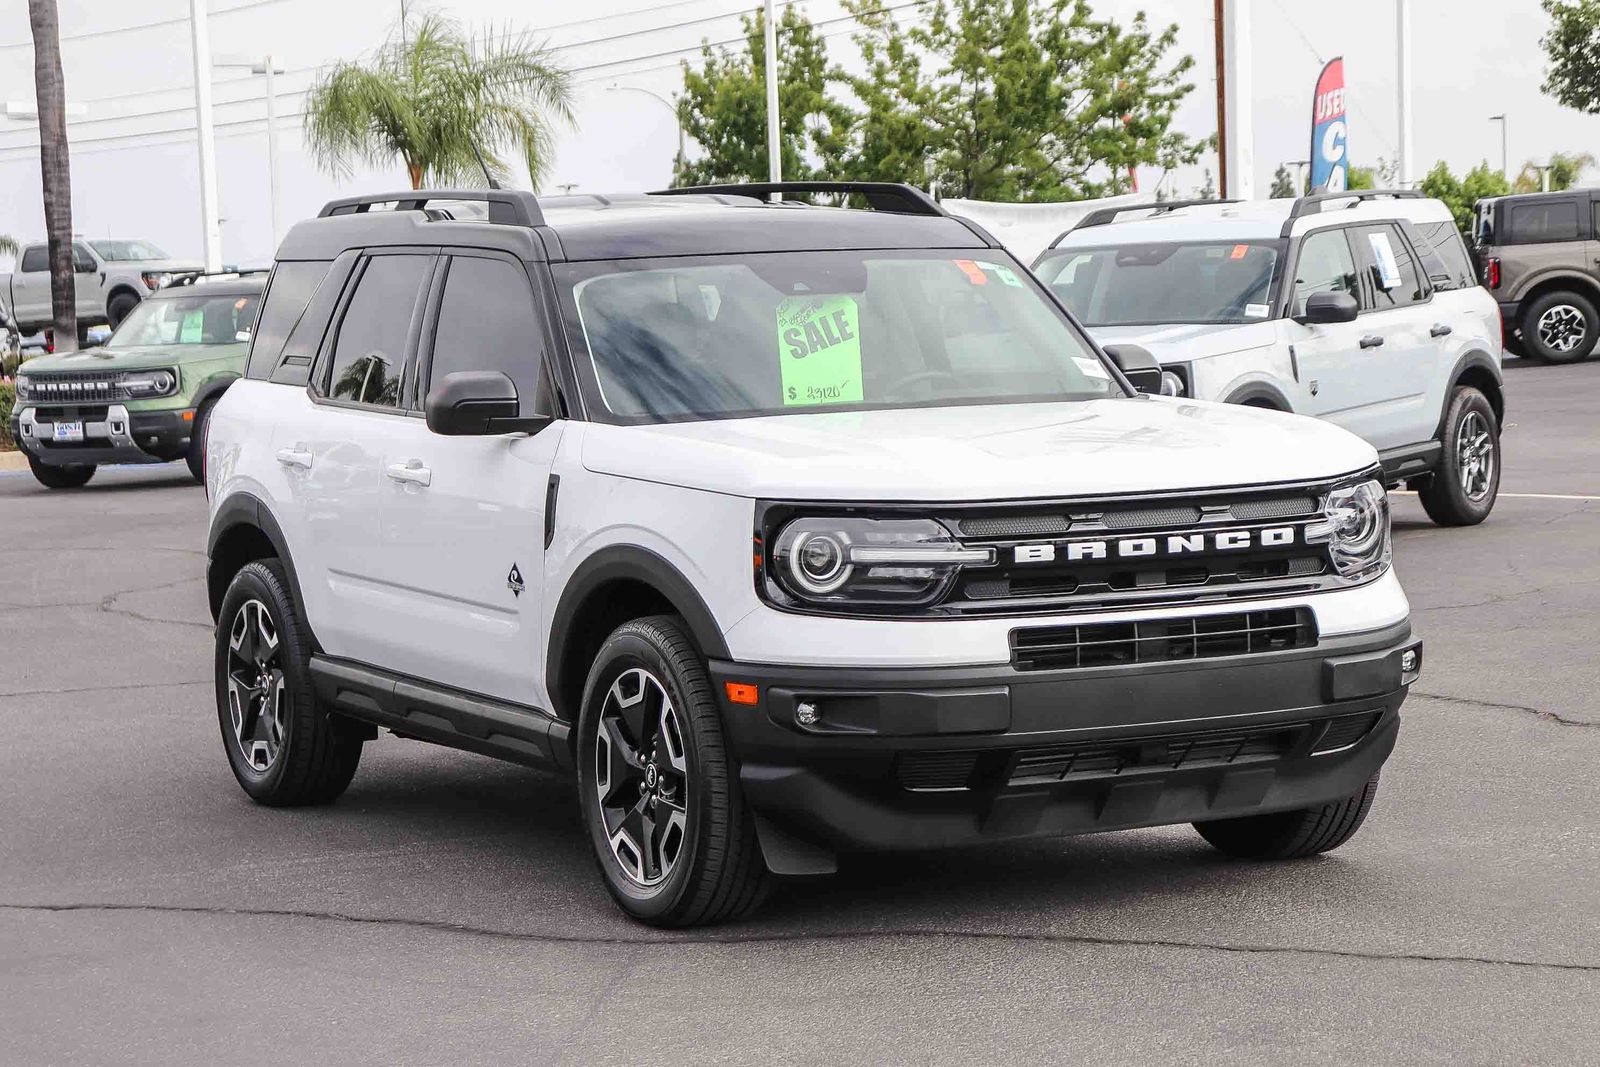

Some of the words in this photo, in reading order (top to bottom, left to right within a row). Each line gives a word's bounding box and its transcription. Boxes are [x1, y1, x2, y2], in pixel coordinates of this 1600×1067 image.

[783, 309, 854, 359] SALE
[36, 382, 109, 391] BRONCO
[788, 386, 797, 400] $
[1014, 527, 1295, 563] BRONCO
